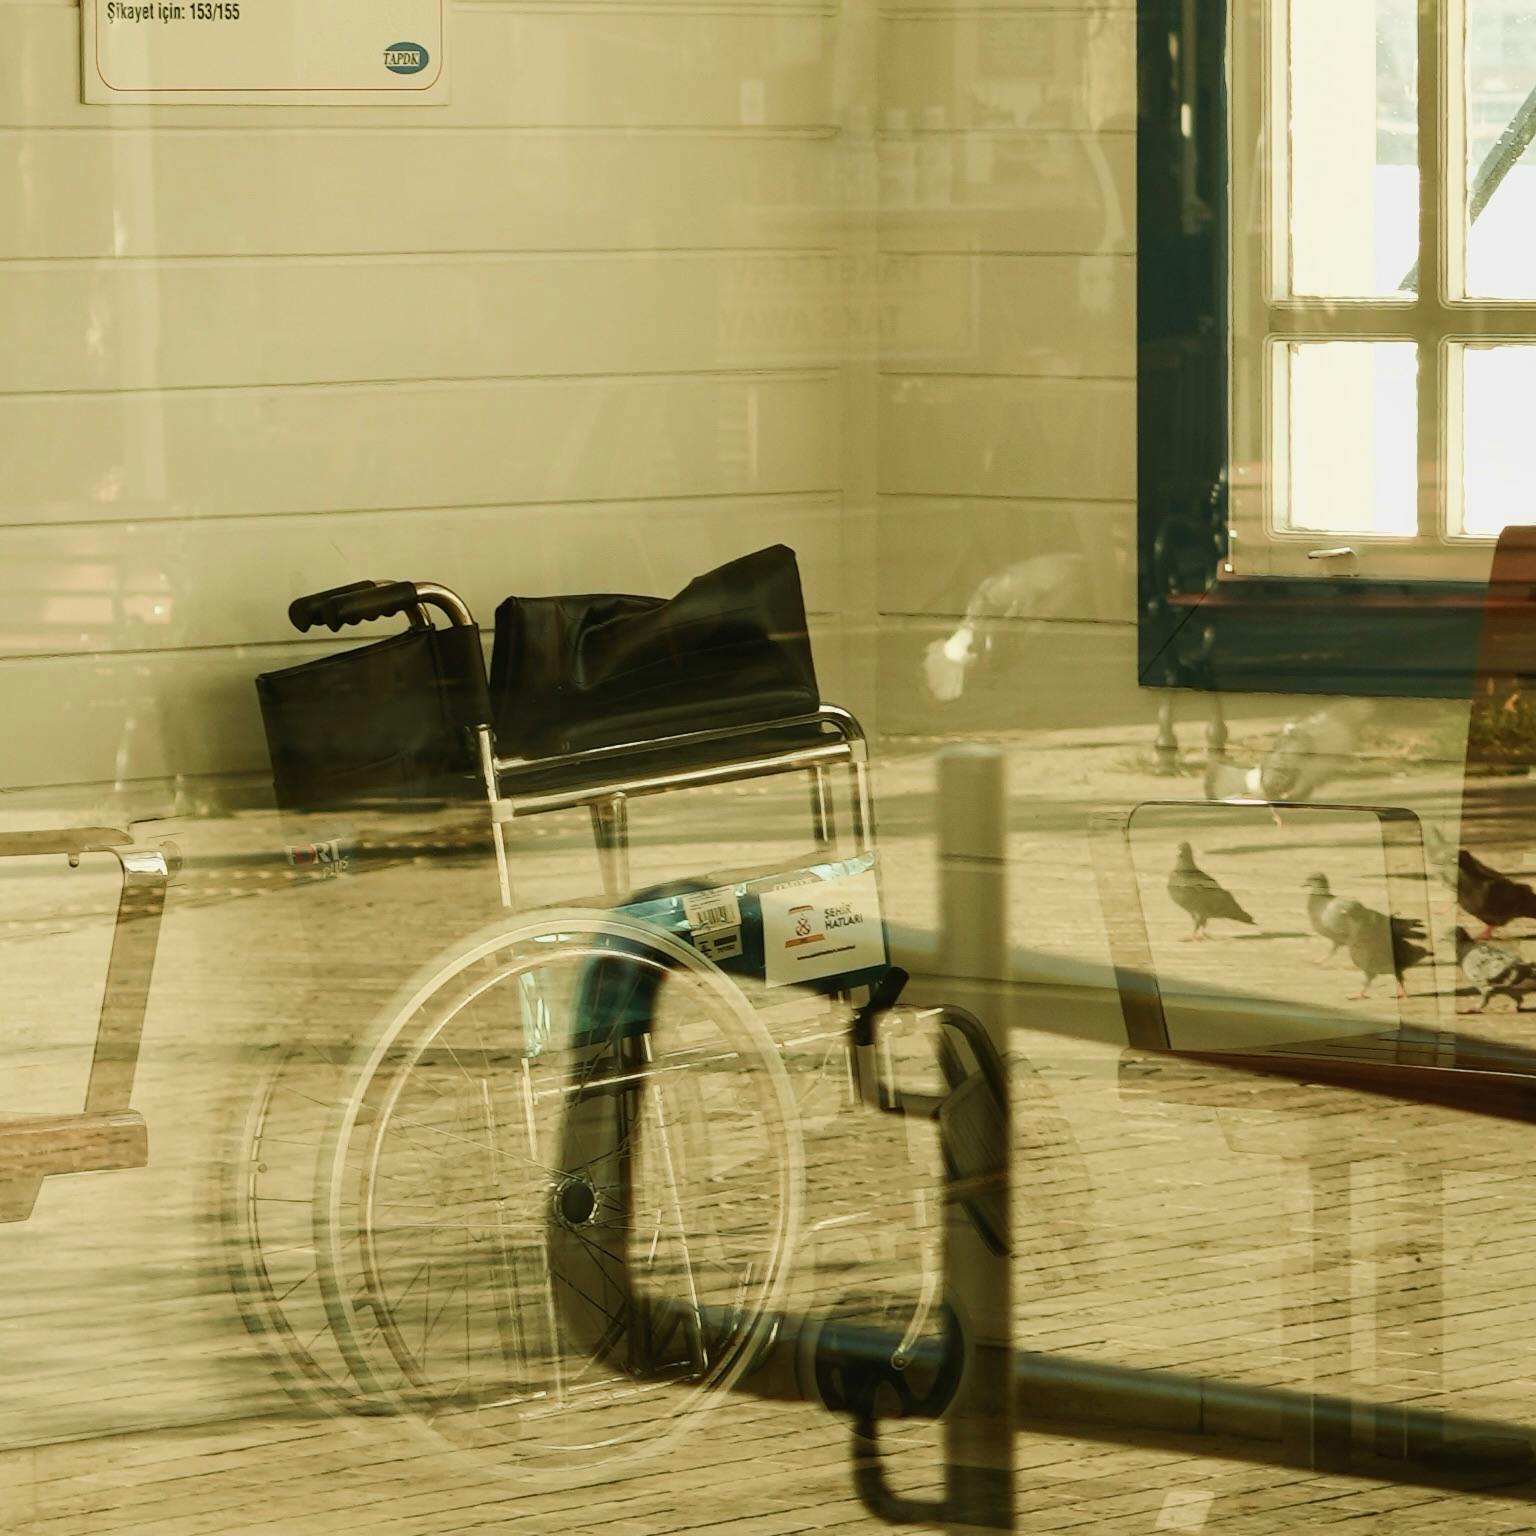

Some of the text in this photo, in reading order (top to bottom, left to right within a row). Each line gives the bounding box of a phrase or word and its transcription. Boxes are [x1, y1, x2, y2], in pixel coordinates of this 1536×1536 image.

[107, 1, 240, 24] Şikayet için: 153/155
[383, 51, 420, 66] TAPDK
